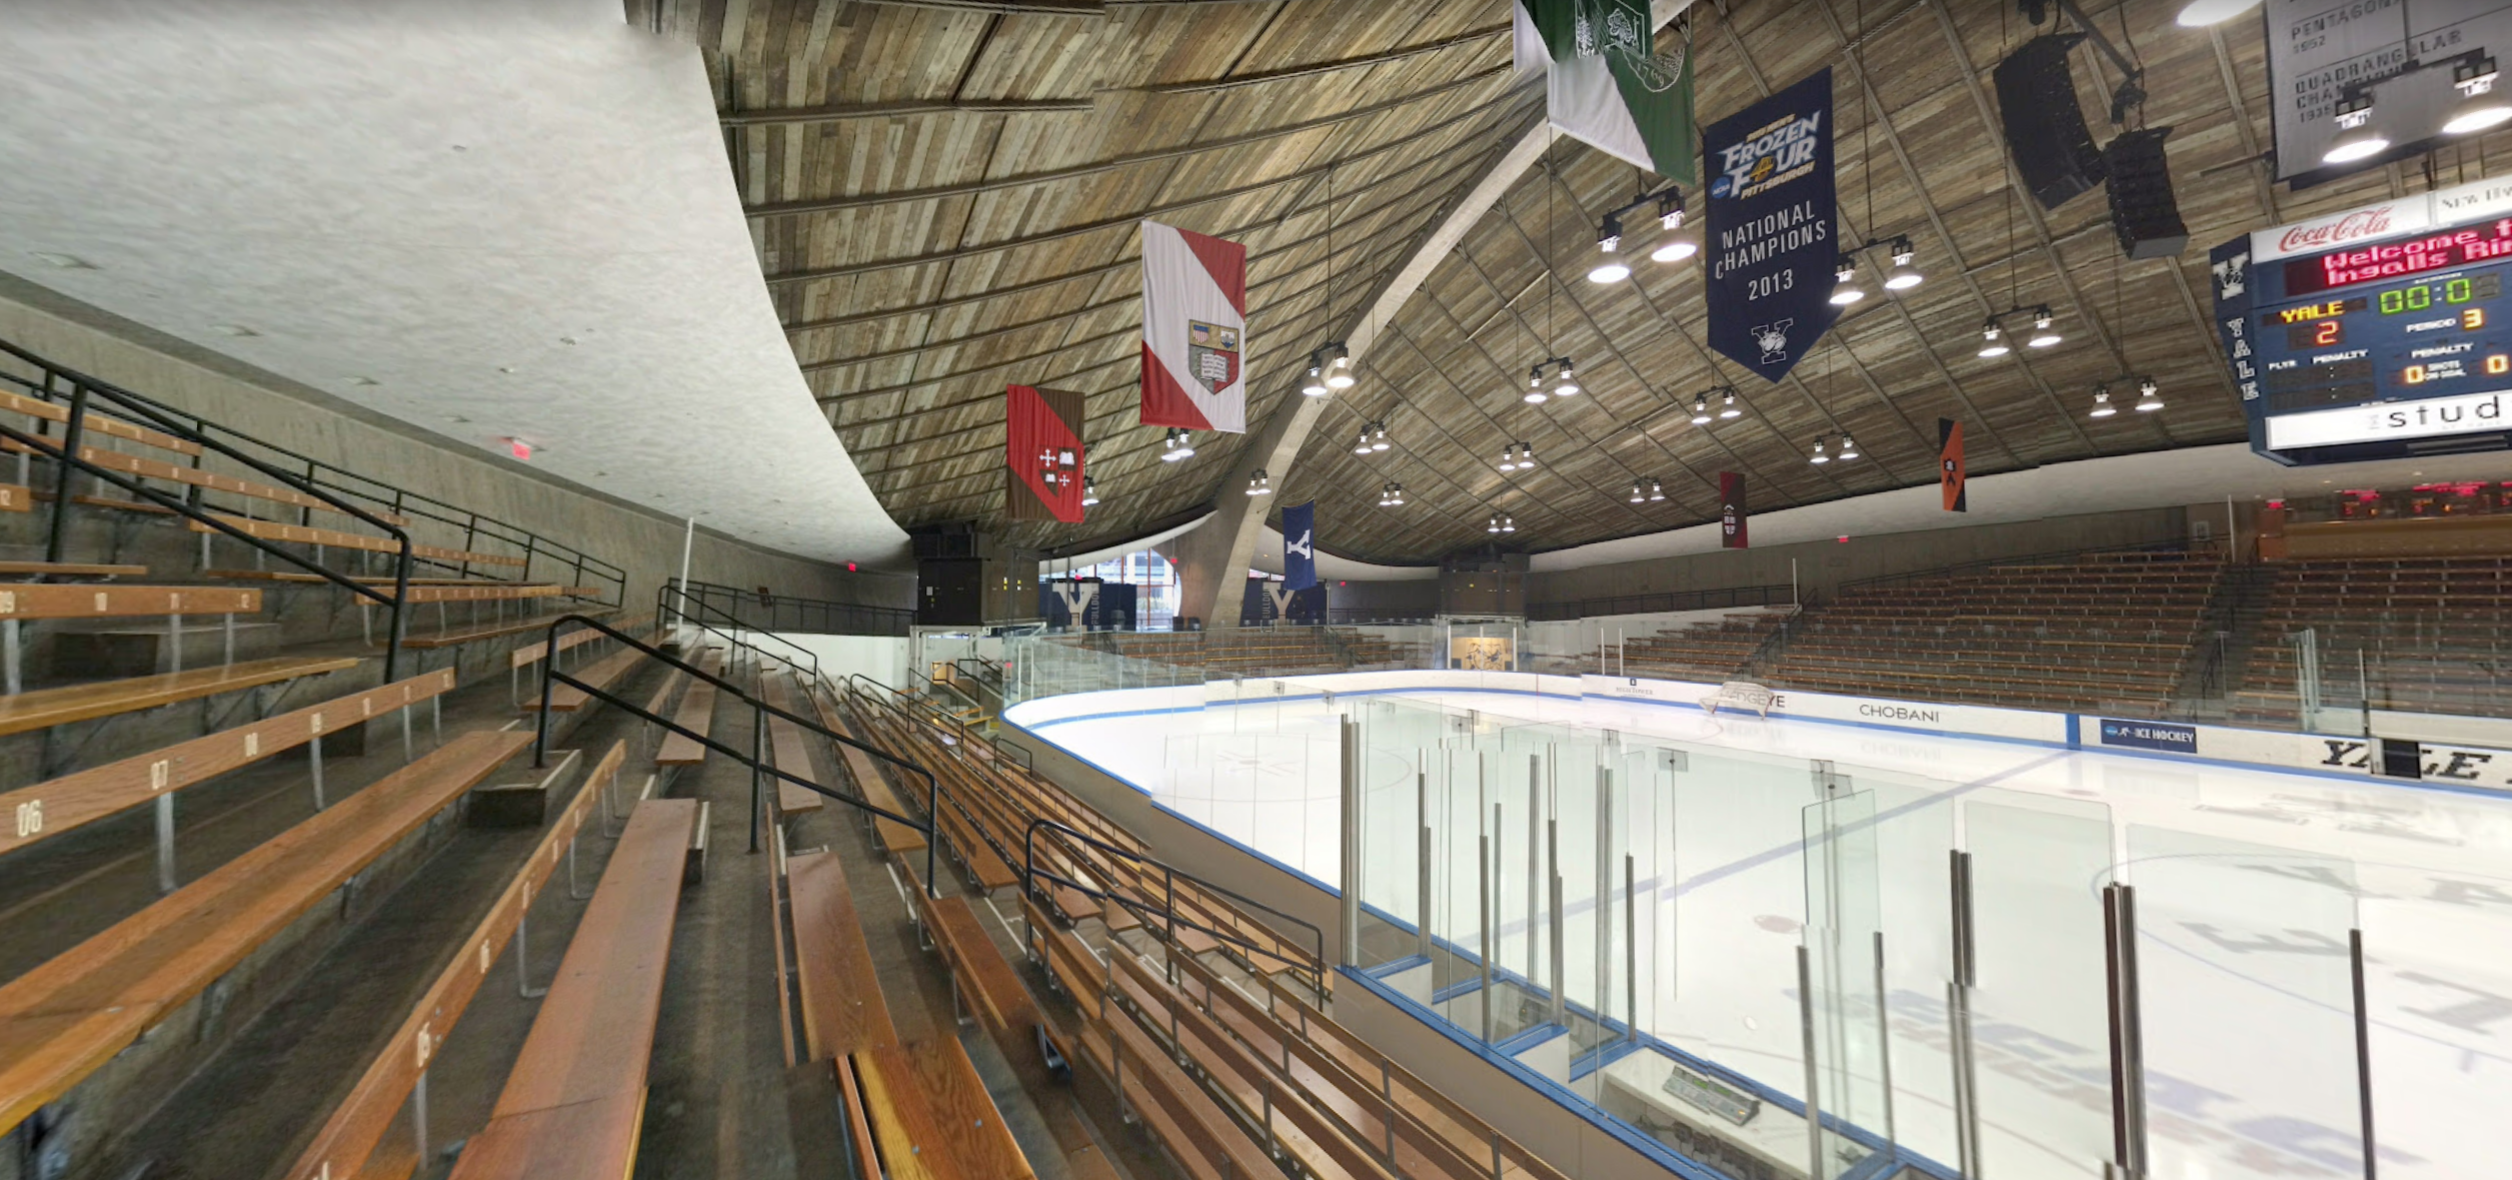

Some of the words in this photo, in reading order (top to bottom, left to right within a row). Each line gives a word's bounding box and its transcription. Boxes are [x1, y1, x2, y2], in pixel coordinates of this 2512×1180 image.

[1717, 110, 1821, 171] FROZEN
[1740, 160, 1816, 200] PITTSBURGH
[1722, 200, 1815, 249] NATIONAL
[1715, 220, 1826, 280] CHAMPIONS
[2324, 230, 2478, 270] Welcome
[2327, 250, 2448, 286] Ingalls
[1748, 268, 1793, 301] 2013
[2281, 300, 2345, 324] YALE
[2463, 307, 2484, 330] 3
[2315, 320, 2340, 346] 2
[2406, 318, 2456, 333] PERIOD
[2226, 317, 2260, 401] YALE
[2312, 348, 2369, 364] PENALTY
[2411, 342, 2475, 359] PENALTY
[2404, 365, 2425, 384] 0
[2486, 355, 2510, 374] 0
[1859, 704, 1940, 723] CHOBANI
[2152, 728, 2195, 743] HOCKEY
[16, 800, 42, 837] 06
